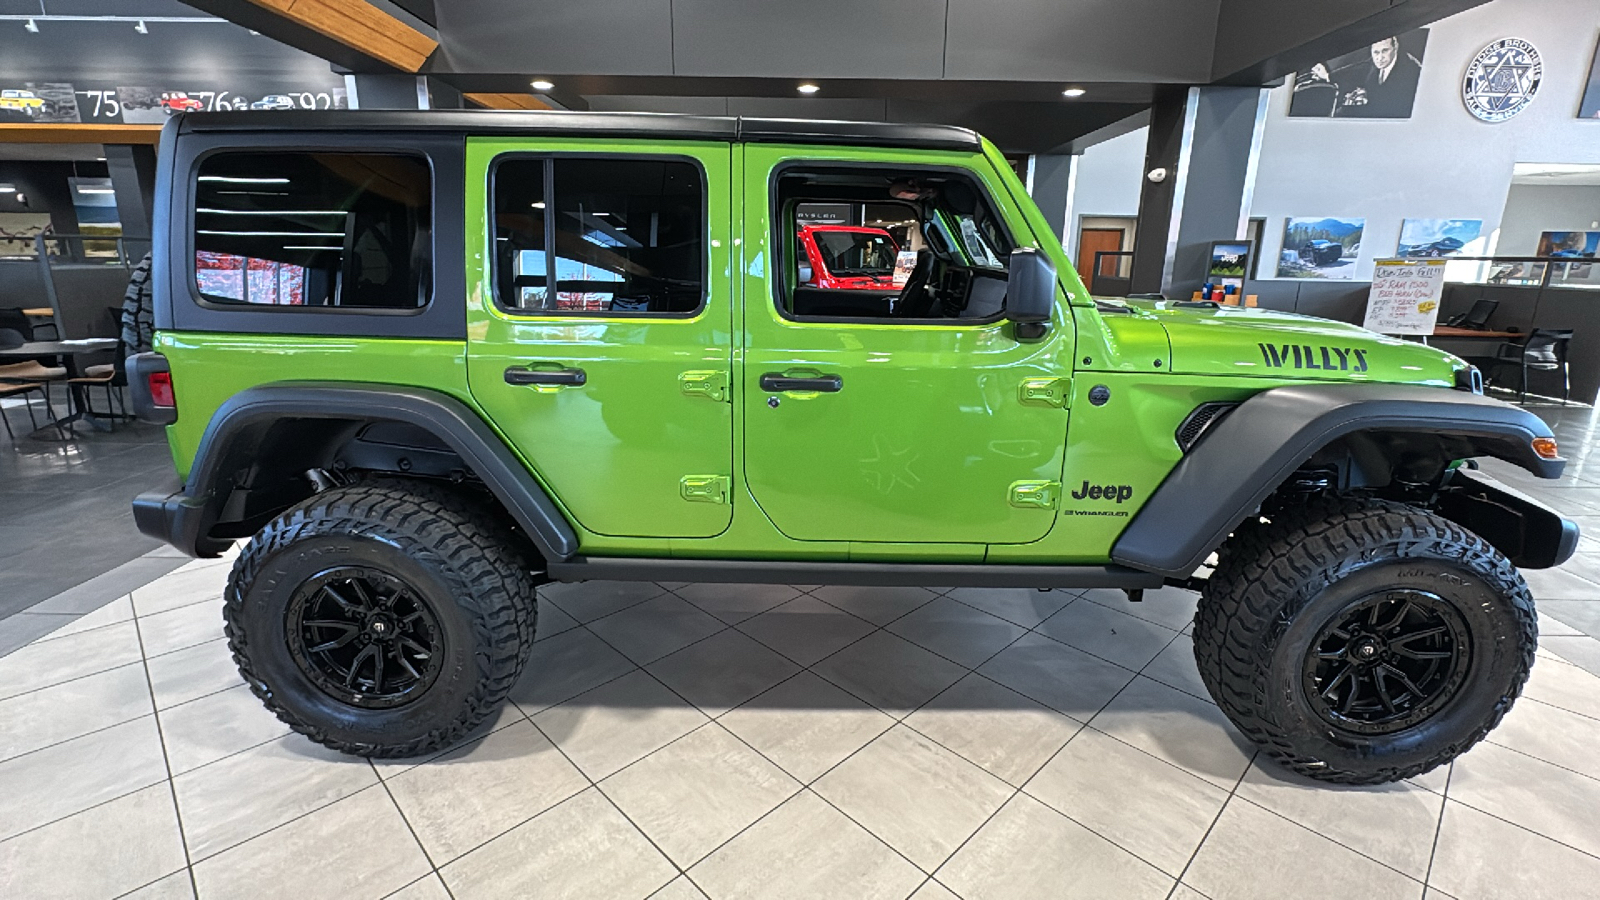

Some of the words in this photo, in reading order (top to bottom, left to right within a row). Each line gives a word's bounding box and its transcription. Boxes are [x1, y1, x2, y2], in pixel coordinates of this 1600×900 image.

[87, 90, 119, 117] 75
[200, 91, 232, 111] 76
[1221, 251, 1239, 264] Jeep
[1258, 342, 1368, 372] WILLYS
[1071, 480, 1132, 503] Jeep
